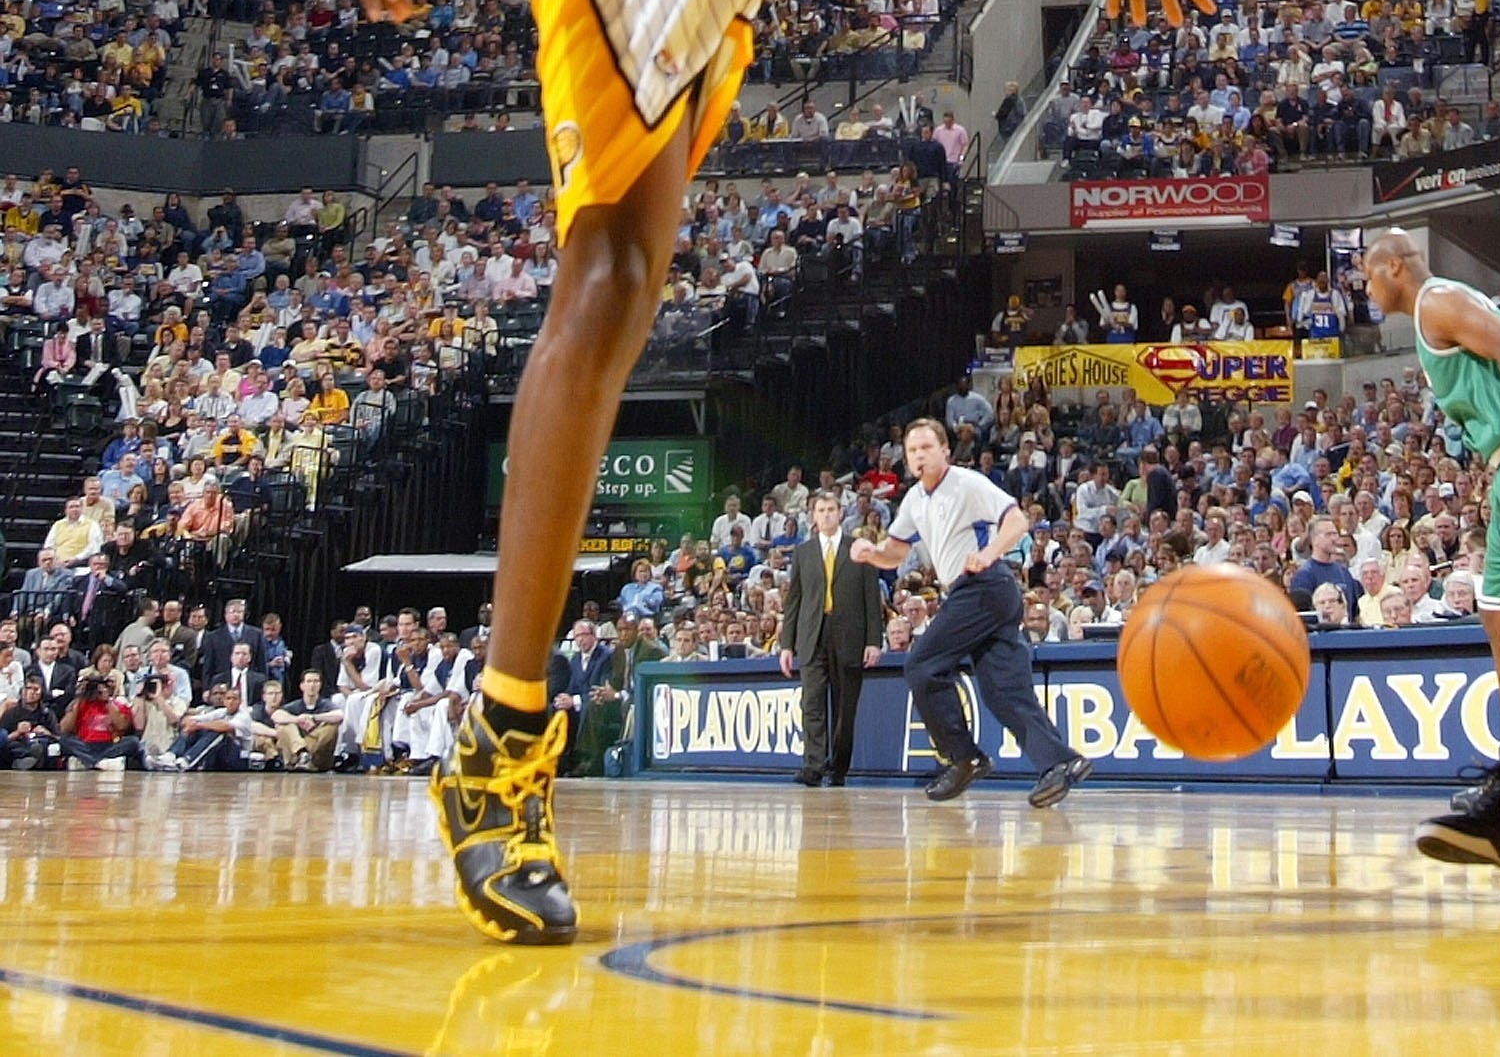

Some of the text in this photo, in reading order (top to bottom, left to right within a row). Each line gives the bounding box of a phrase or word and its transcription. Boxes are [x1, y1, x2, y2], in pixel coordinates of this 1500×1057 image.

[1415, 167, 1466, 192] verizon
[1074, 183, 1265, 207] NORWOOD
[1314, 314, 1329, 328] 31
[1083, 357, 1128, 386] HOUSE
[635, 483, 657, 498] up.
[670, 687, 804, 756] PLAYOFFS
